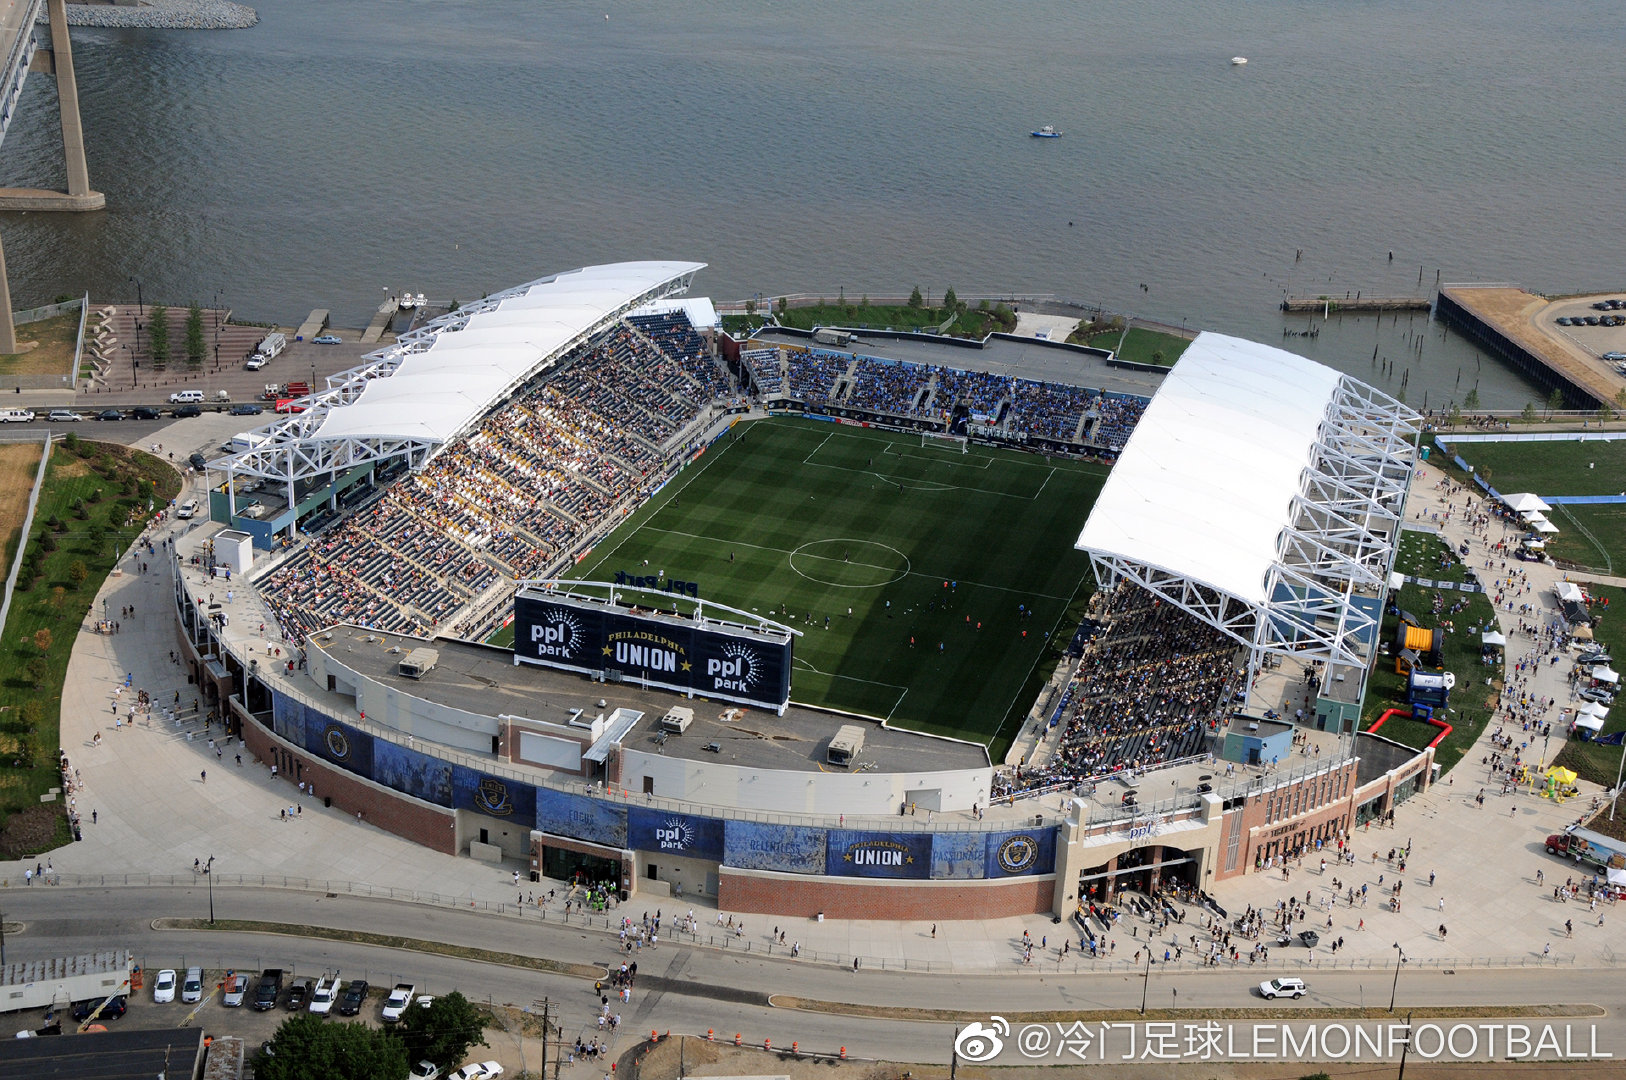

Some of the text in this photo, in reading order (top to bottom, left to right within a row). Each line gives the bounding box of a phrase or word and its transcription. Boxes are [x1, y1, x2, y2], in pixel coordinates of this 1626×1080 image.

[531, 623, 564, 643] ppl
[538, 643, 570, 658] park
[608, 631, 685, 655] PHILADELPHIA
[616, 641, 676, 672] UNION
[708, 657, 742, 677] ppl
[714, 677, 747, 692] park
[656, 828, 680, 840] ppl
[1130, 822, 1151, 840] ppl
[661, 841, 684, 850] park
[849, 841, 909, 853] PHILADELPHIA
[855, 849, 902, 866] UNION
